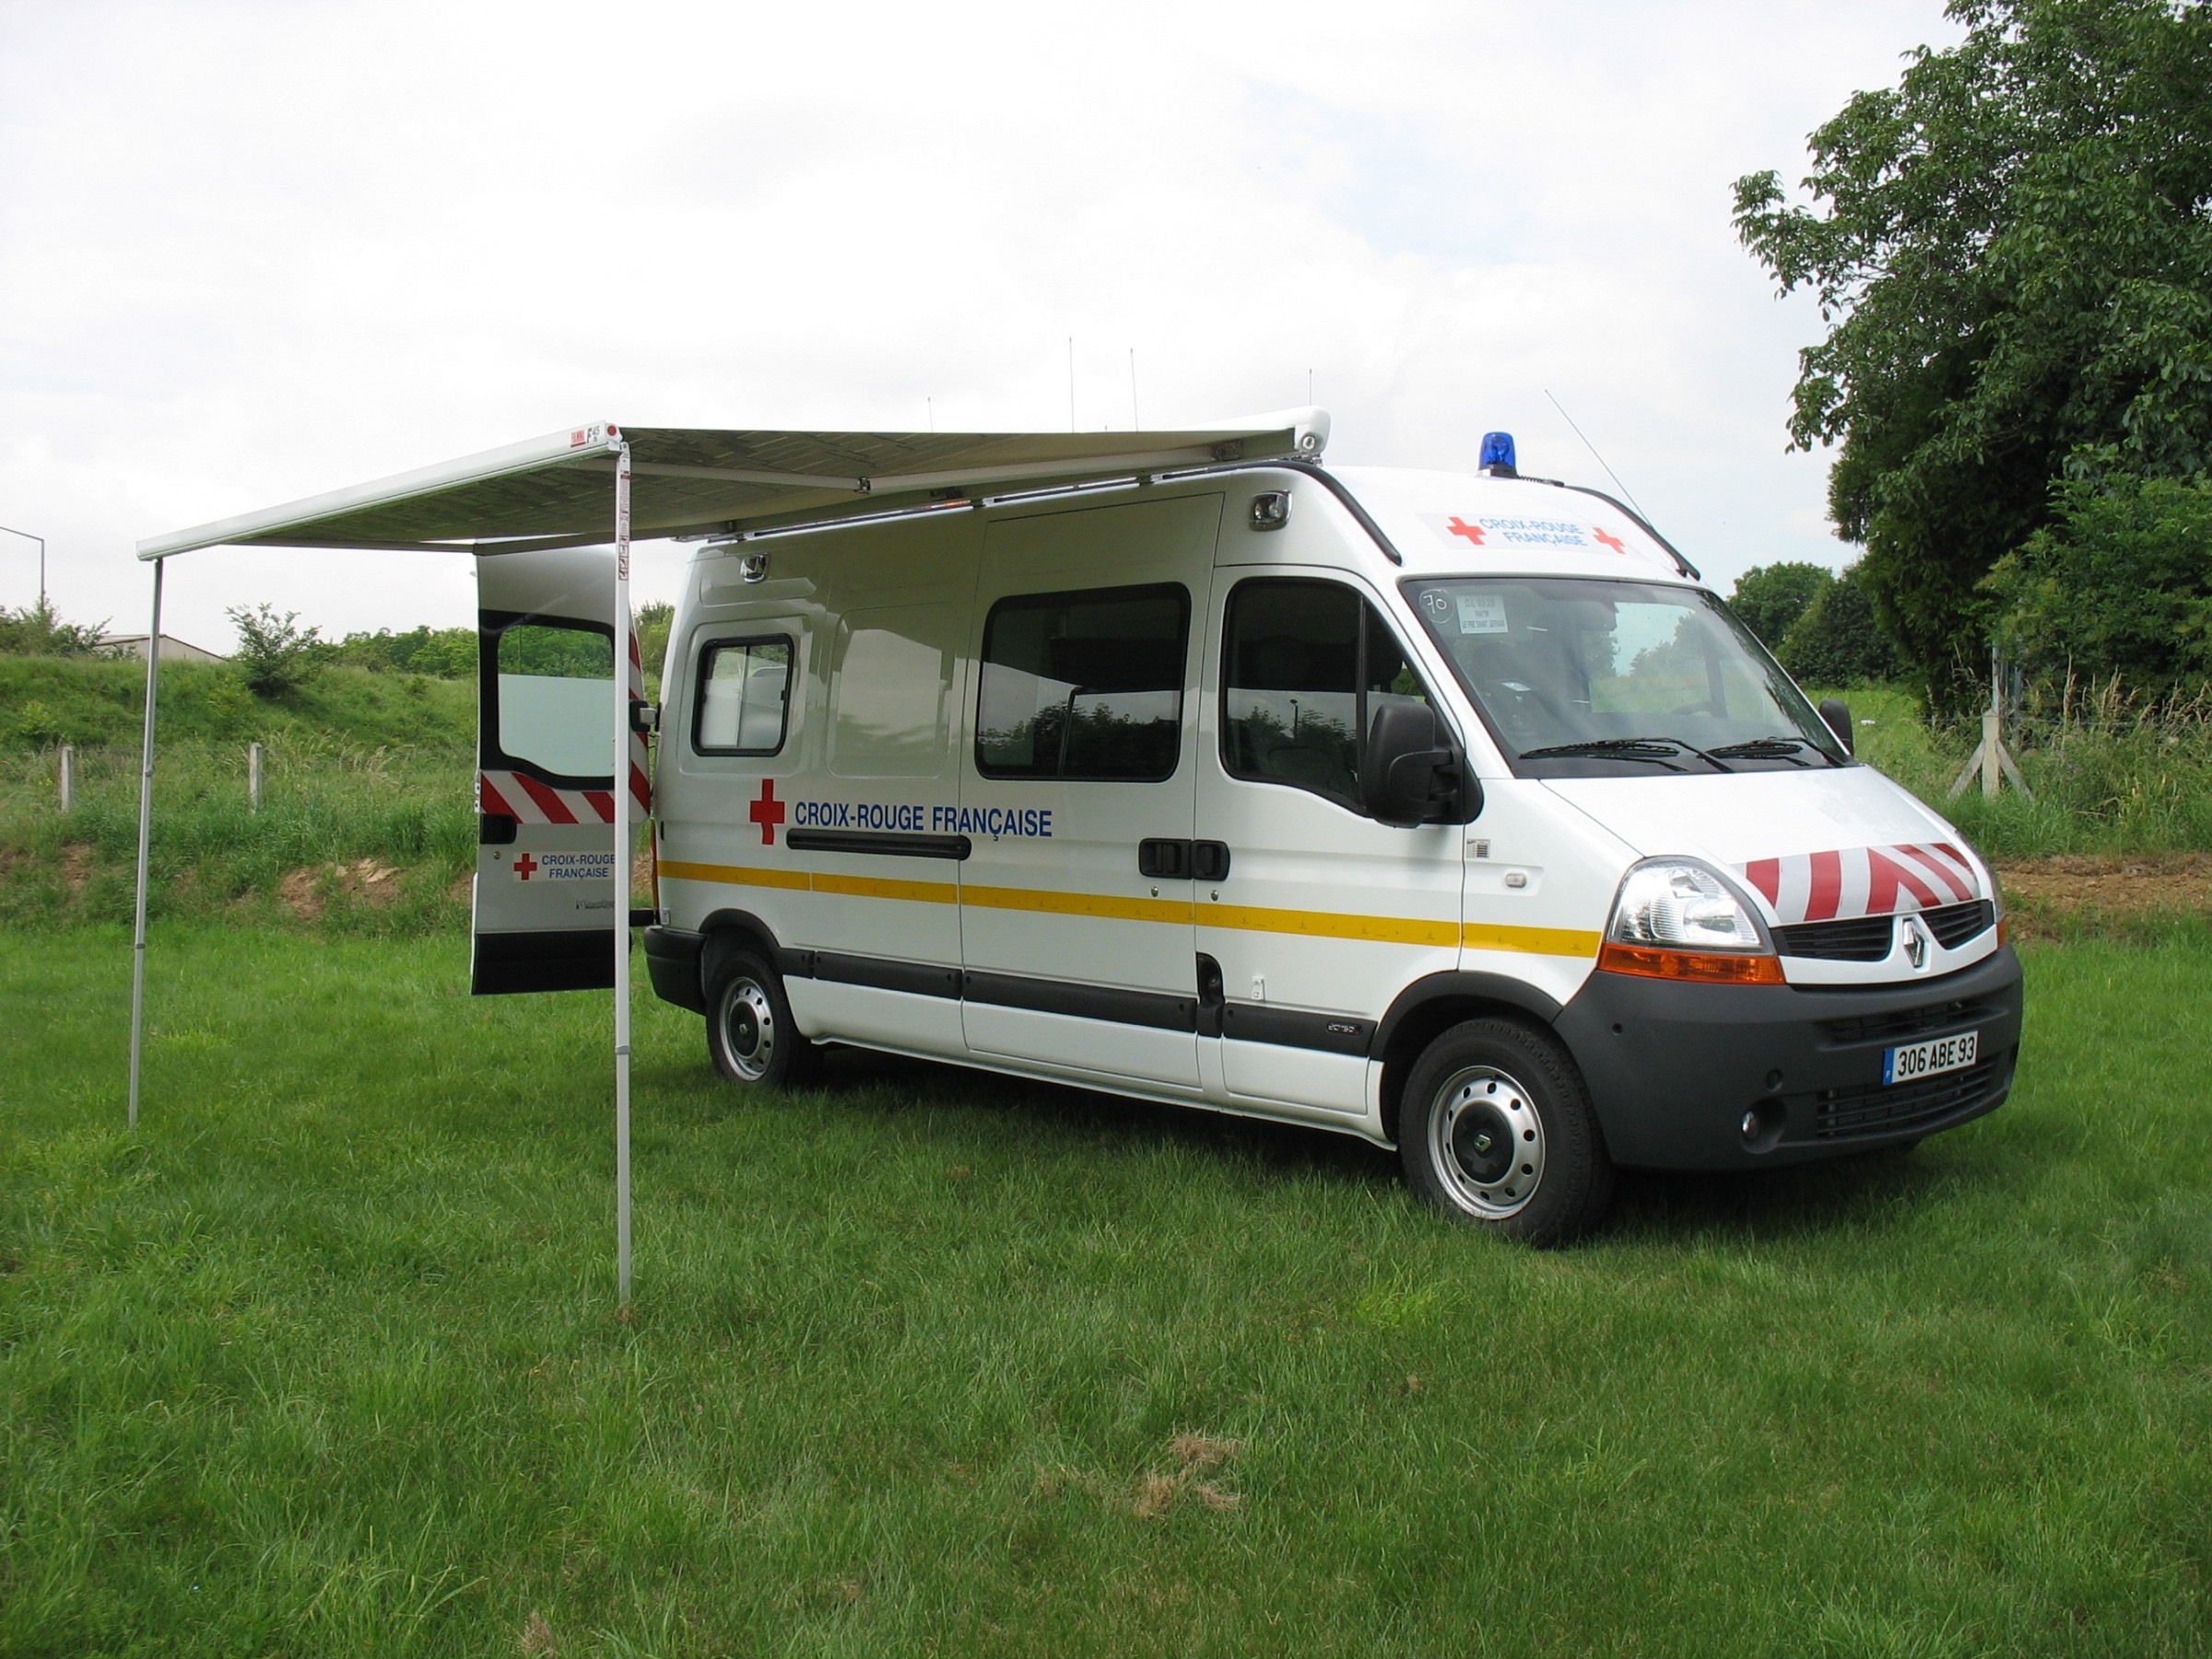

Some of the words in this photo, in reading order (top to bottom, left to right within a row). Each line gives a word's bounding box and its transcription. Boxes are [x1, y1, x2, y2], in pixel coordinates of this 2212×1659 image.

[1478, 518, 1584, 535] CROIX-ROUGE
[1502, 532, 1588, 547] FRANÇAISE
[1423, 594, 1447, 614] 70
[794, 801, 924, 830] CROIX-ROUGE
[932, 806, 1053, 841] FRANÇAISE
[542, 854, 615, 865] CROIX-ROUGE
[549, 867, 608, 880] FRANÇAISE
[1898, 1047, 1926, 1077] 306
[1929, 1041, 1956, 1069] ABE
[1958, 1036, 1975, 1063] 93
